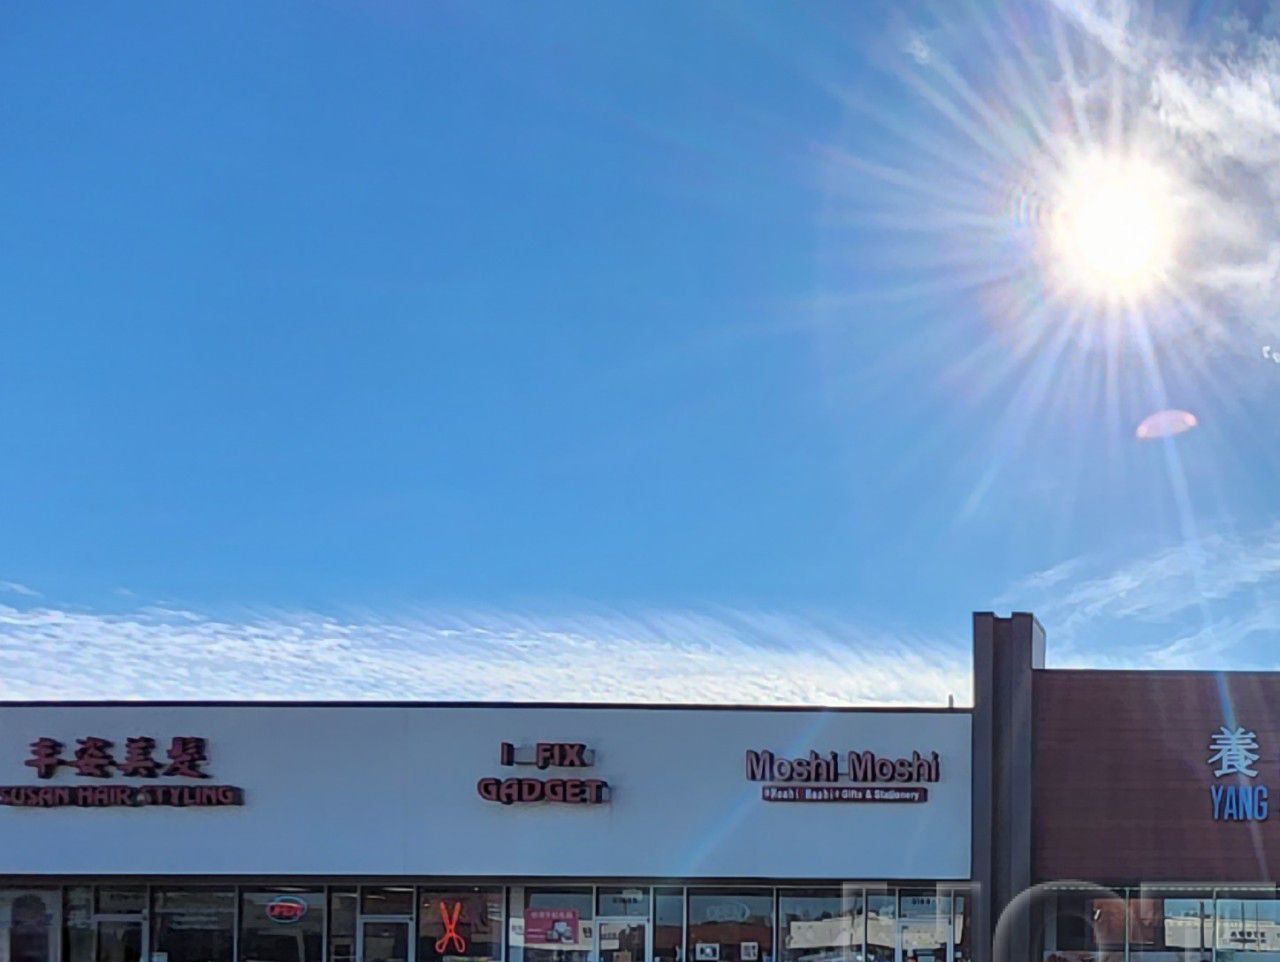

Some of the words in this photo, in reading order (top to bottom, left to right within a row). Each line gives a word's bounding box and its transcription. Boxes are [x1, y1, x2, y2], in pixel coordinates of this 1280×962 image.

[537, 743, 586, 769] FIX
[747, 750, 838, 782] Moshi
[849, 750, 939, 782] Moshi
[77, 786, 132, 804] HAIR
[478, 778, 604, 804] GADGET
[1210, 783, 1268, 822] YANG
